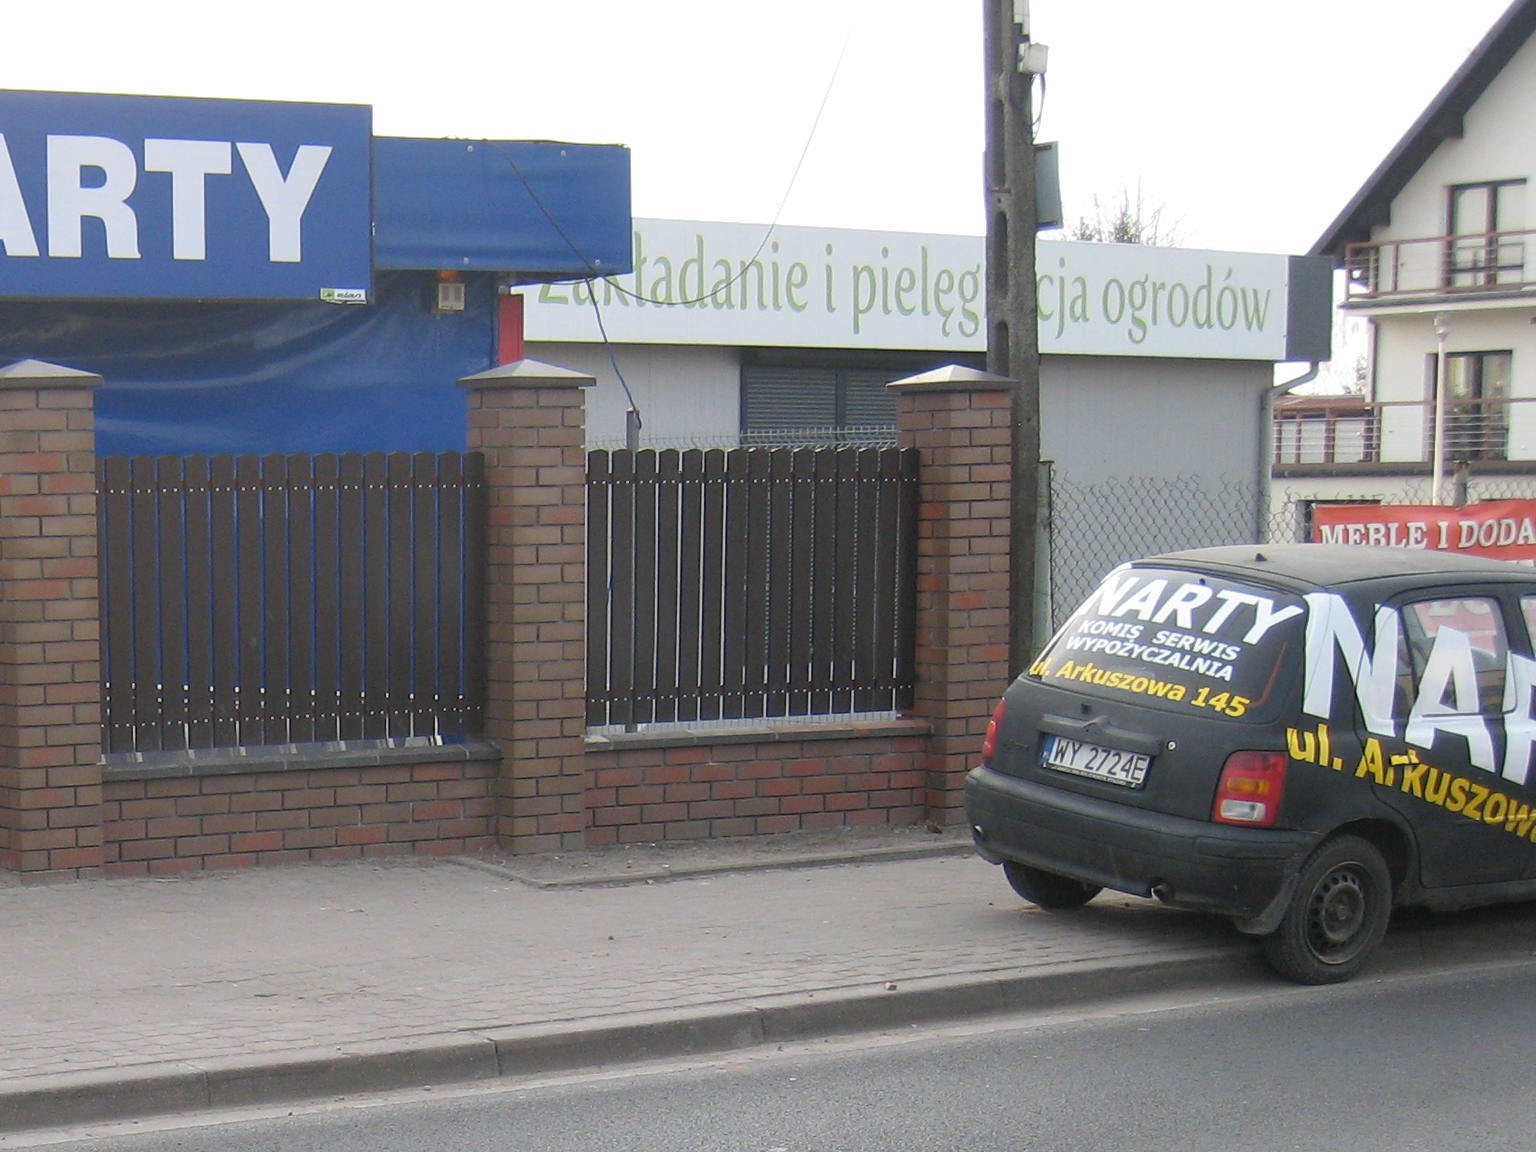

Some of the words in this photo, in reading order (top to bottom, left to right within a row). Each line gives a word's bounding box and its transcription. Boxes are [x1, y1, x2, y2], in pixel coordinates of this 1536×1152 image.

[537, 231, 809, 313] ładanie
[825, 243, 837, 313] i
[853, 245, 1090, 339] pielęgcja
[1102, 263, 1272, 344] ogrodów
[1320, 521, 1428, 549] MEBLE
[1437, 520, 1450, 549] I
[1076, 576, 1305, 646] NARTY
[1077, 618, 1144, 640] KOMIS
[1152, 630, 1242, 662] SERWIS
[1056, 659, 1188, 702] Arkuszowa
[1191, 686, 1251, 718] 145
[1052, 738, 1082, 767] WY
[1084, 747, 1148, 782] 2724E
[1286, 722, 1344, 772] ul.
[1354, 736, 1536, 844] Arkuszow
